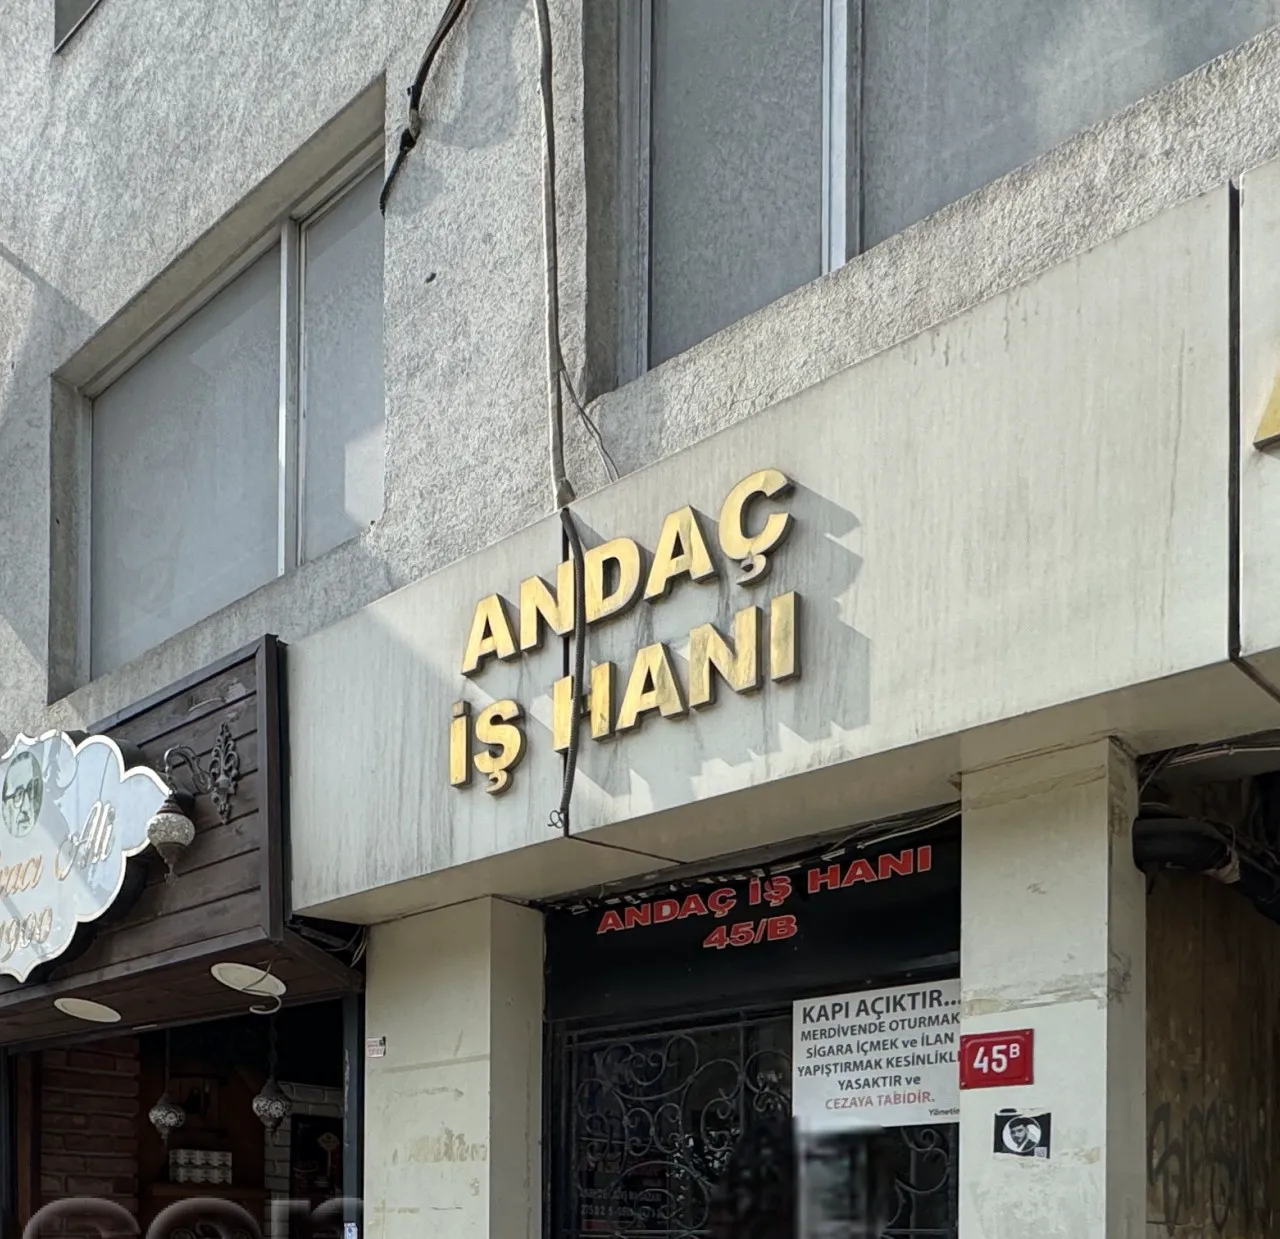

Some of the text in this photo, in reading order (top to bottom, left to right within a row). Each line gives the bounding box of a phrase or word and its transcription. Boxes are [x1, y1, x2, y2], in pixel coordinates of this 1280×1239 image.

[461, 468, 795, 675] ANDAÇ
[449, 591, 800, 795] İŞ HANI
[597, 845, 932, 934] ANDAÇ İŞ HANI
[702, 914, 798, 949] 45/B
[801, 1012, 960, 1042] MERDİVENDE OTURMAK
[802, 1001, 849, 1024] KAPI
[806, 1032, 954, 1059] SİGARA İÇMEK ve İLAN
[798, 1050, 960, 1078] YAPIŞTIRMAK KESİNLİKL
[838, 1075, 921, 1091] YASAKTIR ve
[826, 1090, 935, 1110] CEZAYA TABİDİR.
